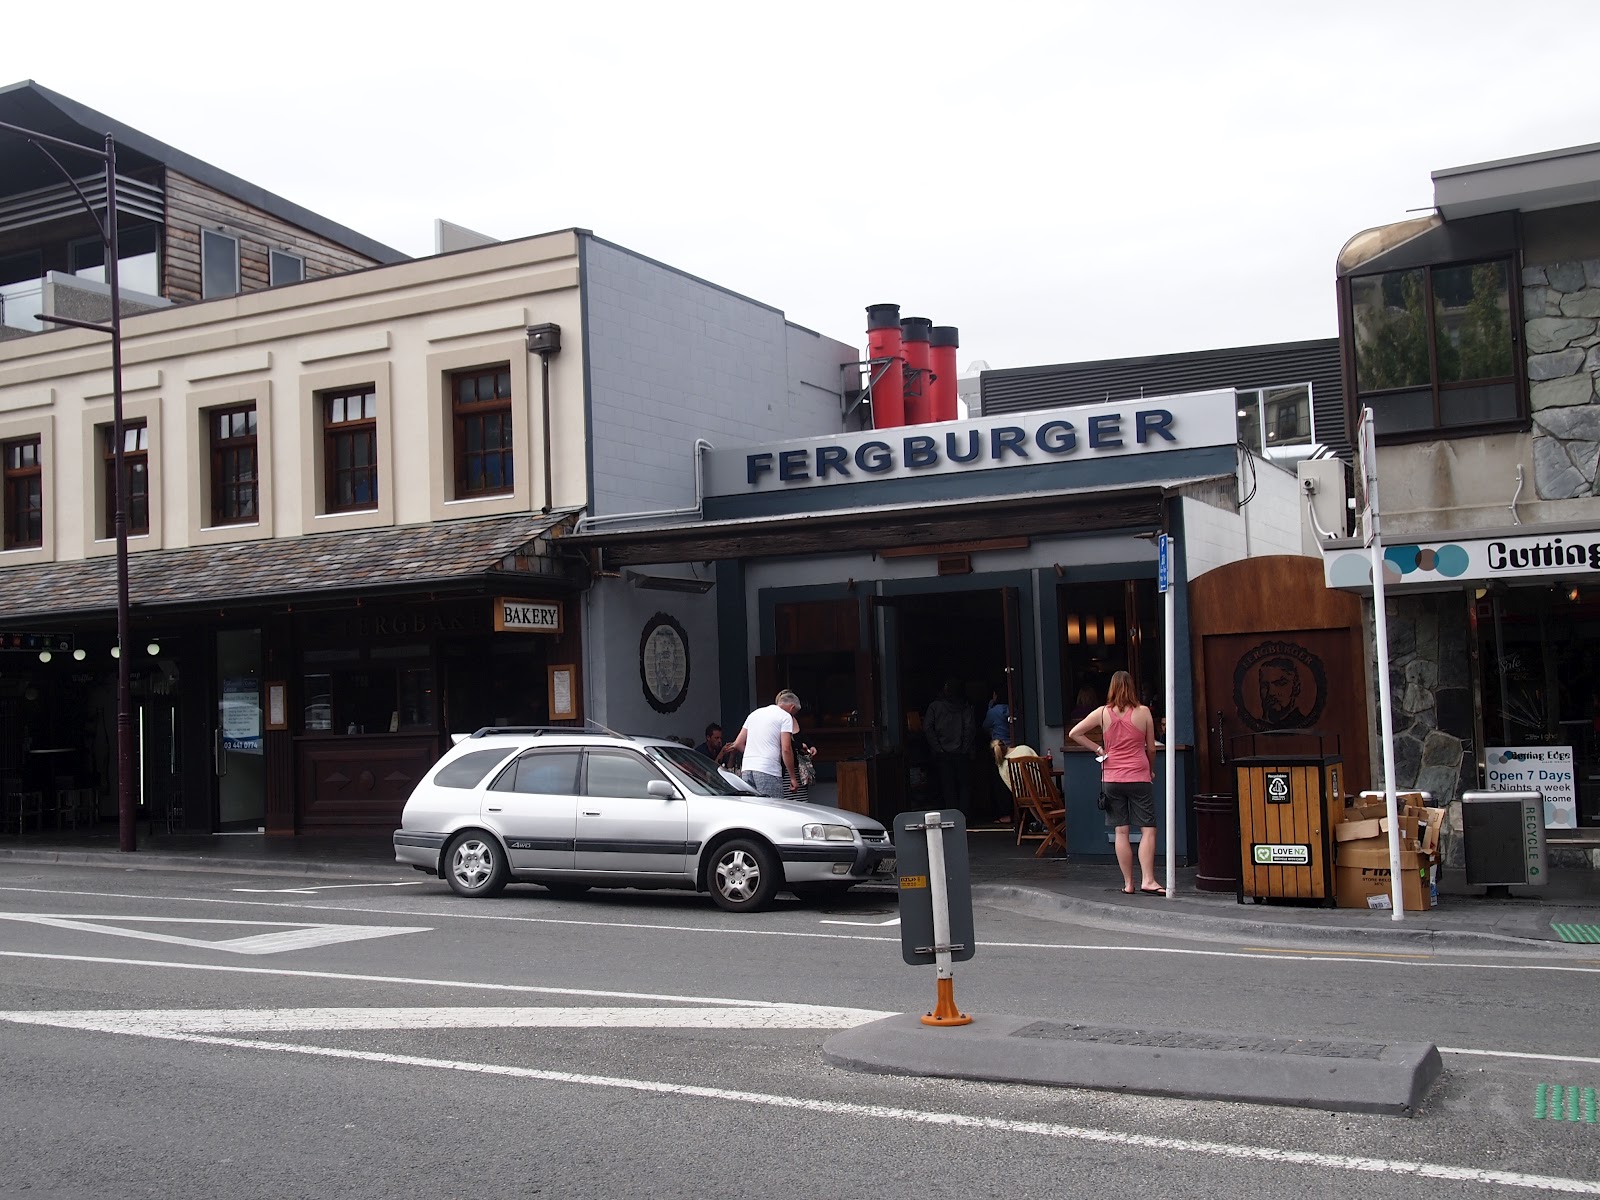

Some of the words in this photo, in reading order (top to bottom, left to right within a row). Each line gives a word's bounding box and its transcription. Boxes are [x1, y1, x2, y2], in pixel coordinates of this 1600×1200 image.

[747, 409, 1177, 485] FERGBURGER
[1487, 538, 1600, 569] Cutting
[504, 607, 556, 625] BAKERY
[1242, 645, 1313, 670] FERGBURGER
[243, 741, 258, 749] 0774
[1547, 751, 1571, 761] Edge
[1489, 770, 1523, 782] Open
[1527, 770, 1535, 780] 7
[1539, 770, 1571, 782] Days
[1499, 783, 1532, 791] Nights
[1544, 783, 1571, 791] week
[1525, 807, 1539, 859] RECYCLE
